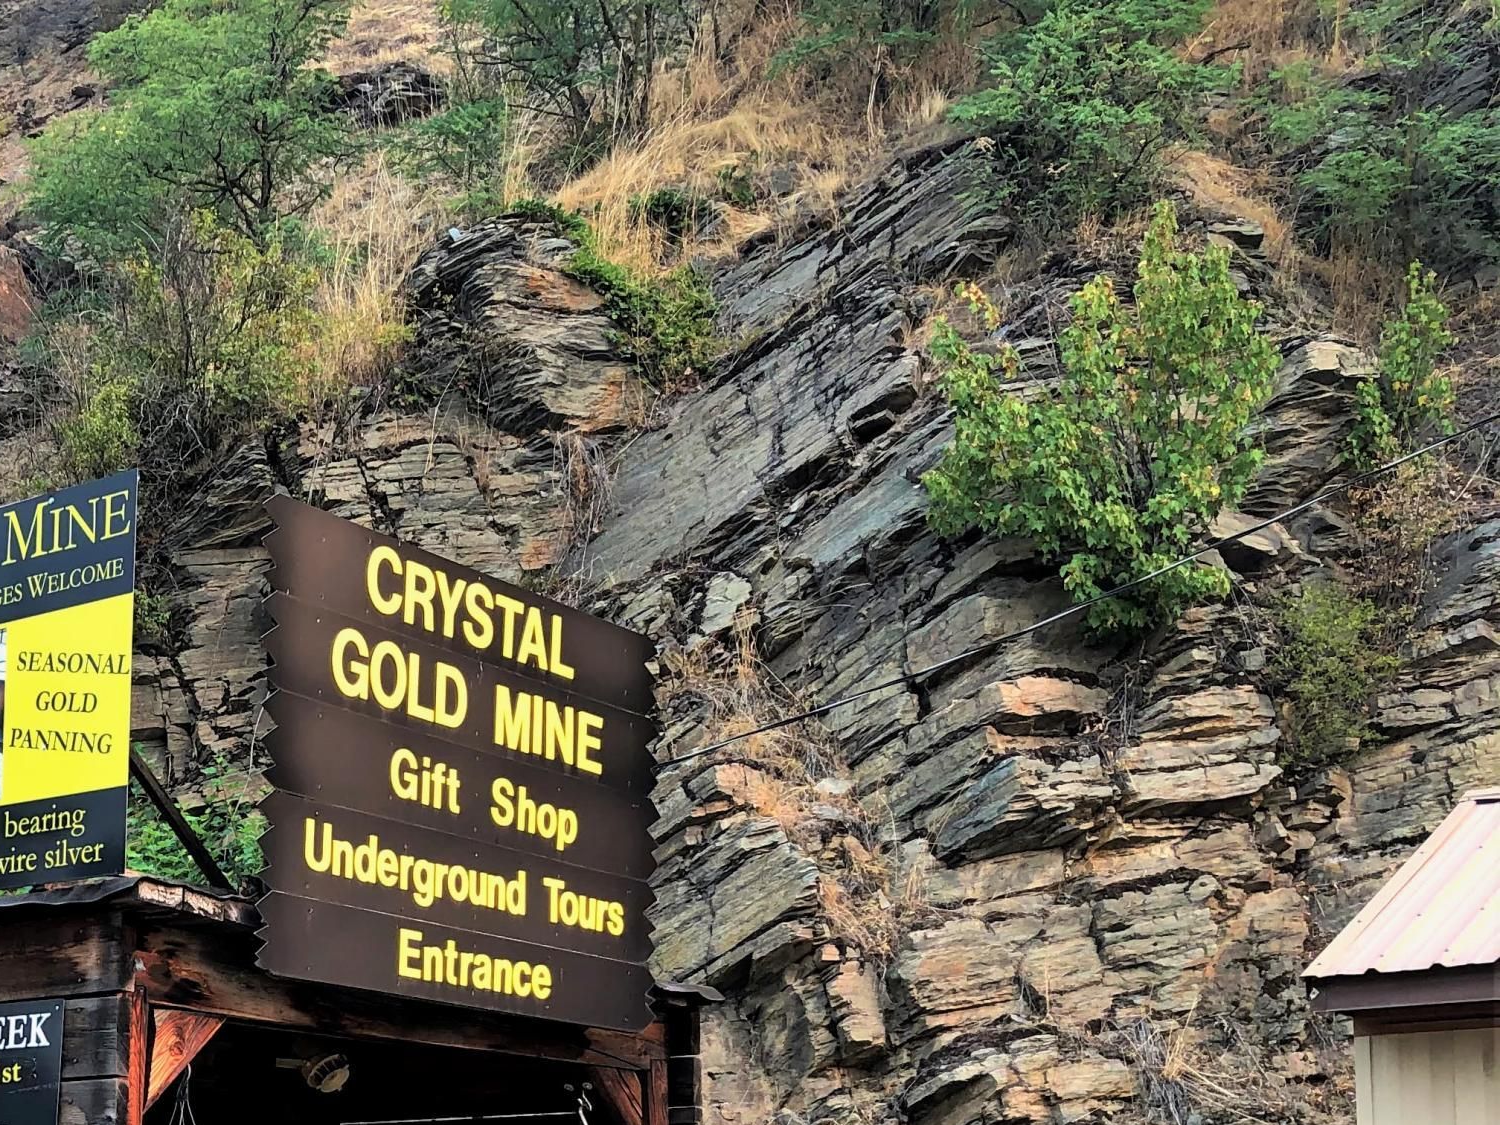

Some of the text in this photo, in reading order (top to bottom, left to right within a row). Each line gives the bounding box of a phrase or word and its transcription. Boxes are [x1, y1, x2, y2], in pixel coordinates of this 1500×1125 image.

[1, 489, 131, 567] MINE
[27, 557, 124, 599] WELCOME
[366, 545, 575, 680] CRYSTAL
[16, 651, 130, 675] SEASONAL
[35, 691, 98, 714] GOLD
[331, 627, 604, 775] GOLD MINE
[9, 728, 112, 755] PANNING
[4, 804, 86, 837] bearing
[389, 748, 579, 850] Gift Shop
[44, 839, 104, 870] silver
[304, 818, 625, 937] Underground Tours
[397, 928, 553, 1001] Entrance
